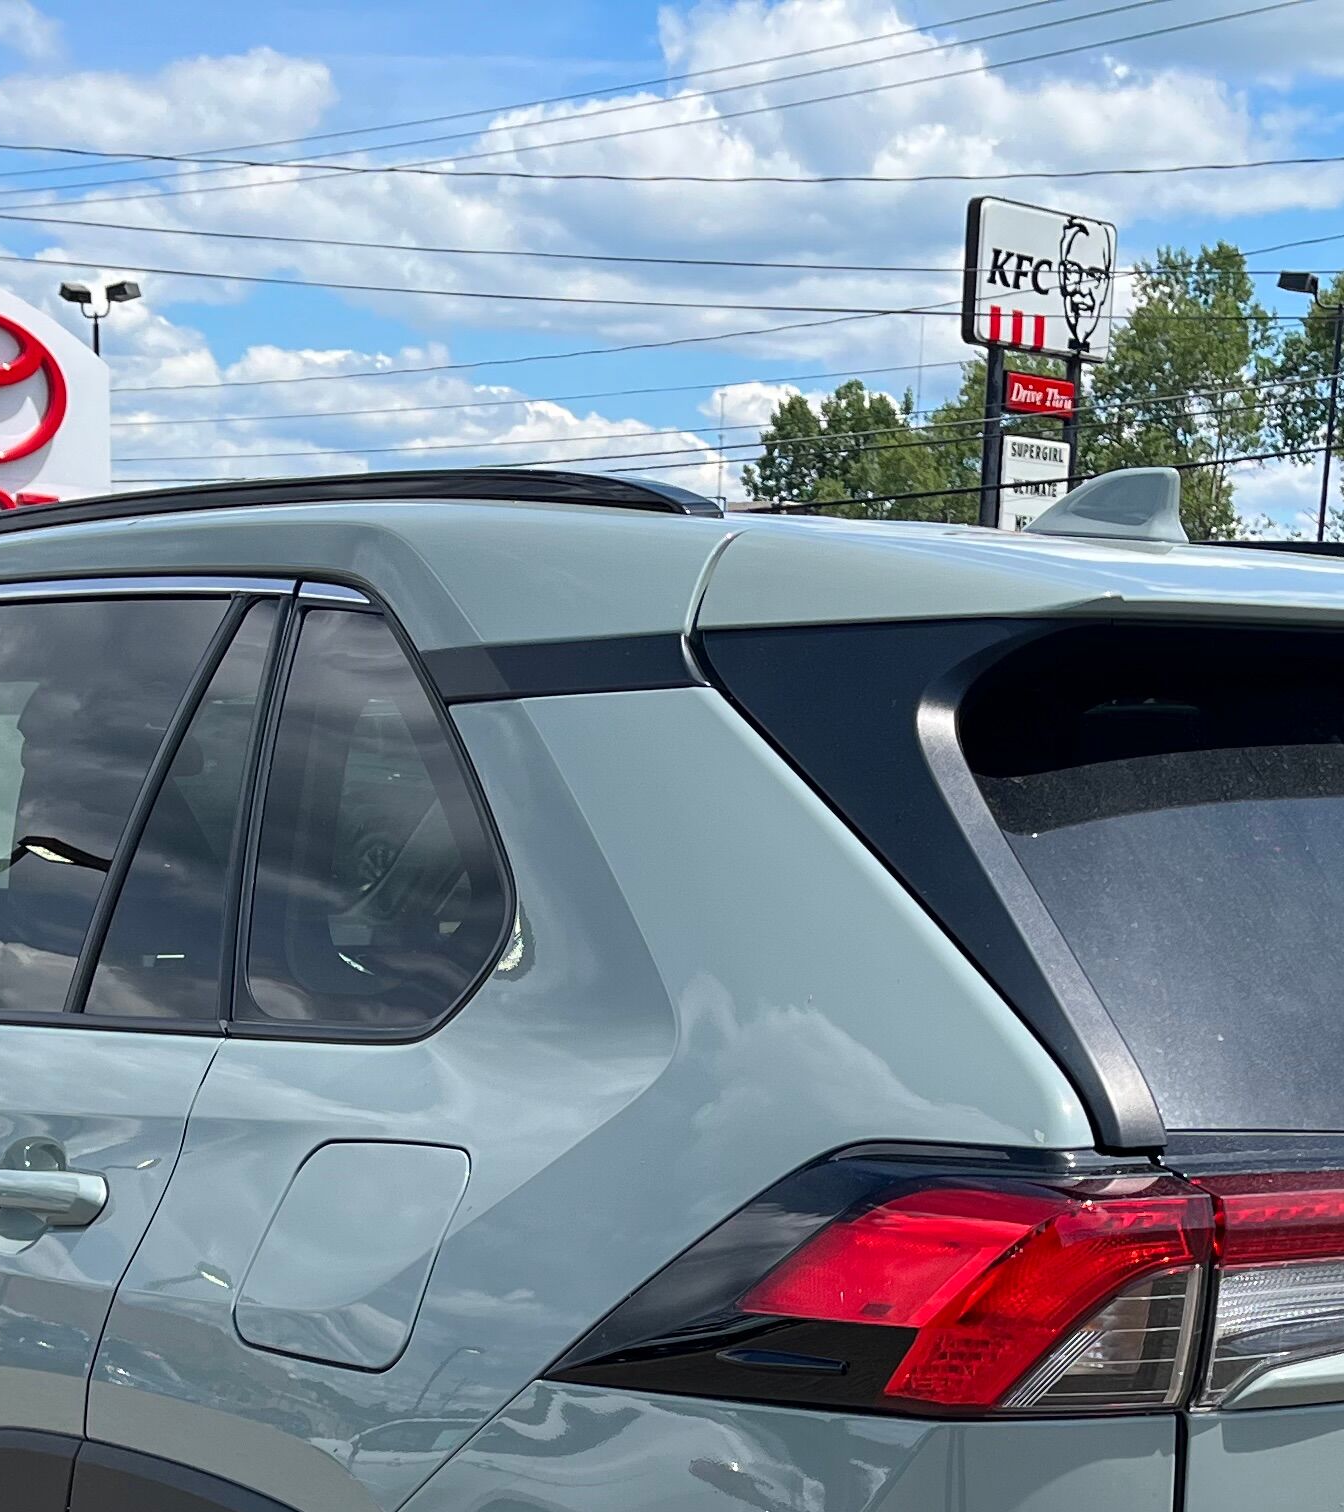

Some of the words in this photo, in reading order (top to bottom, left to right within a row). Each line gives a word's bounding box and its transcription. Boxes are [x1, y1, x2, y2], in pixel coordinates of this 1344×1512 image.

[987, 248, 1053, 296] KFC
[1011, 382, 1044, 406] Drive
[1045, 387, 1073, 411] Thru
[1011, 441, 1064, 463] SUPERGIRL
